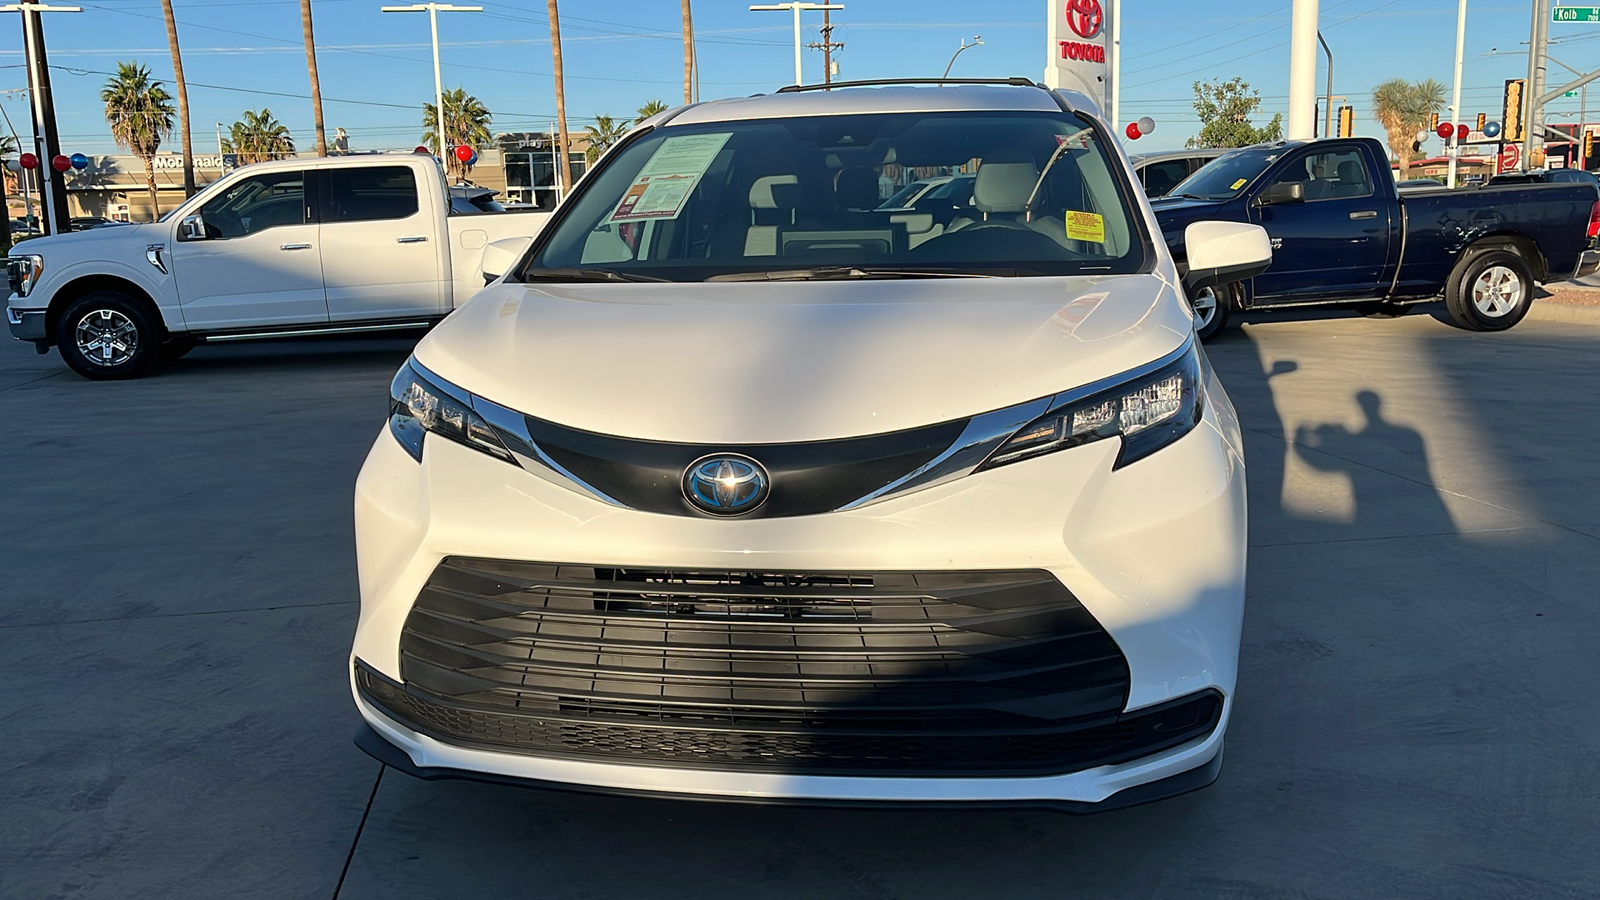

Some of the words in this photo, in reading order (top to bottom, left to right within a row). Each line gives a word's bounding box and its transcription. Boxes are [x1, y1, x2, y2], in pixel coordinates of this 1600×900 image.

[1558, 9, 1577, 20] Kolb
[1059, 41, 1105, 63] TOYOTA
[154, 157, 234, 168] McDnald's
